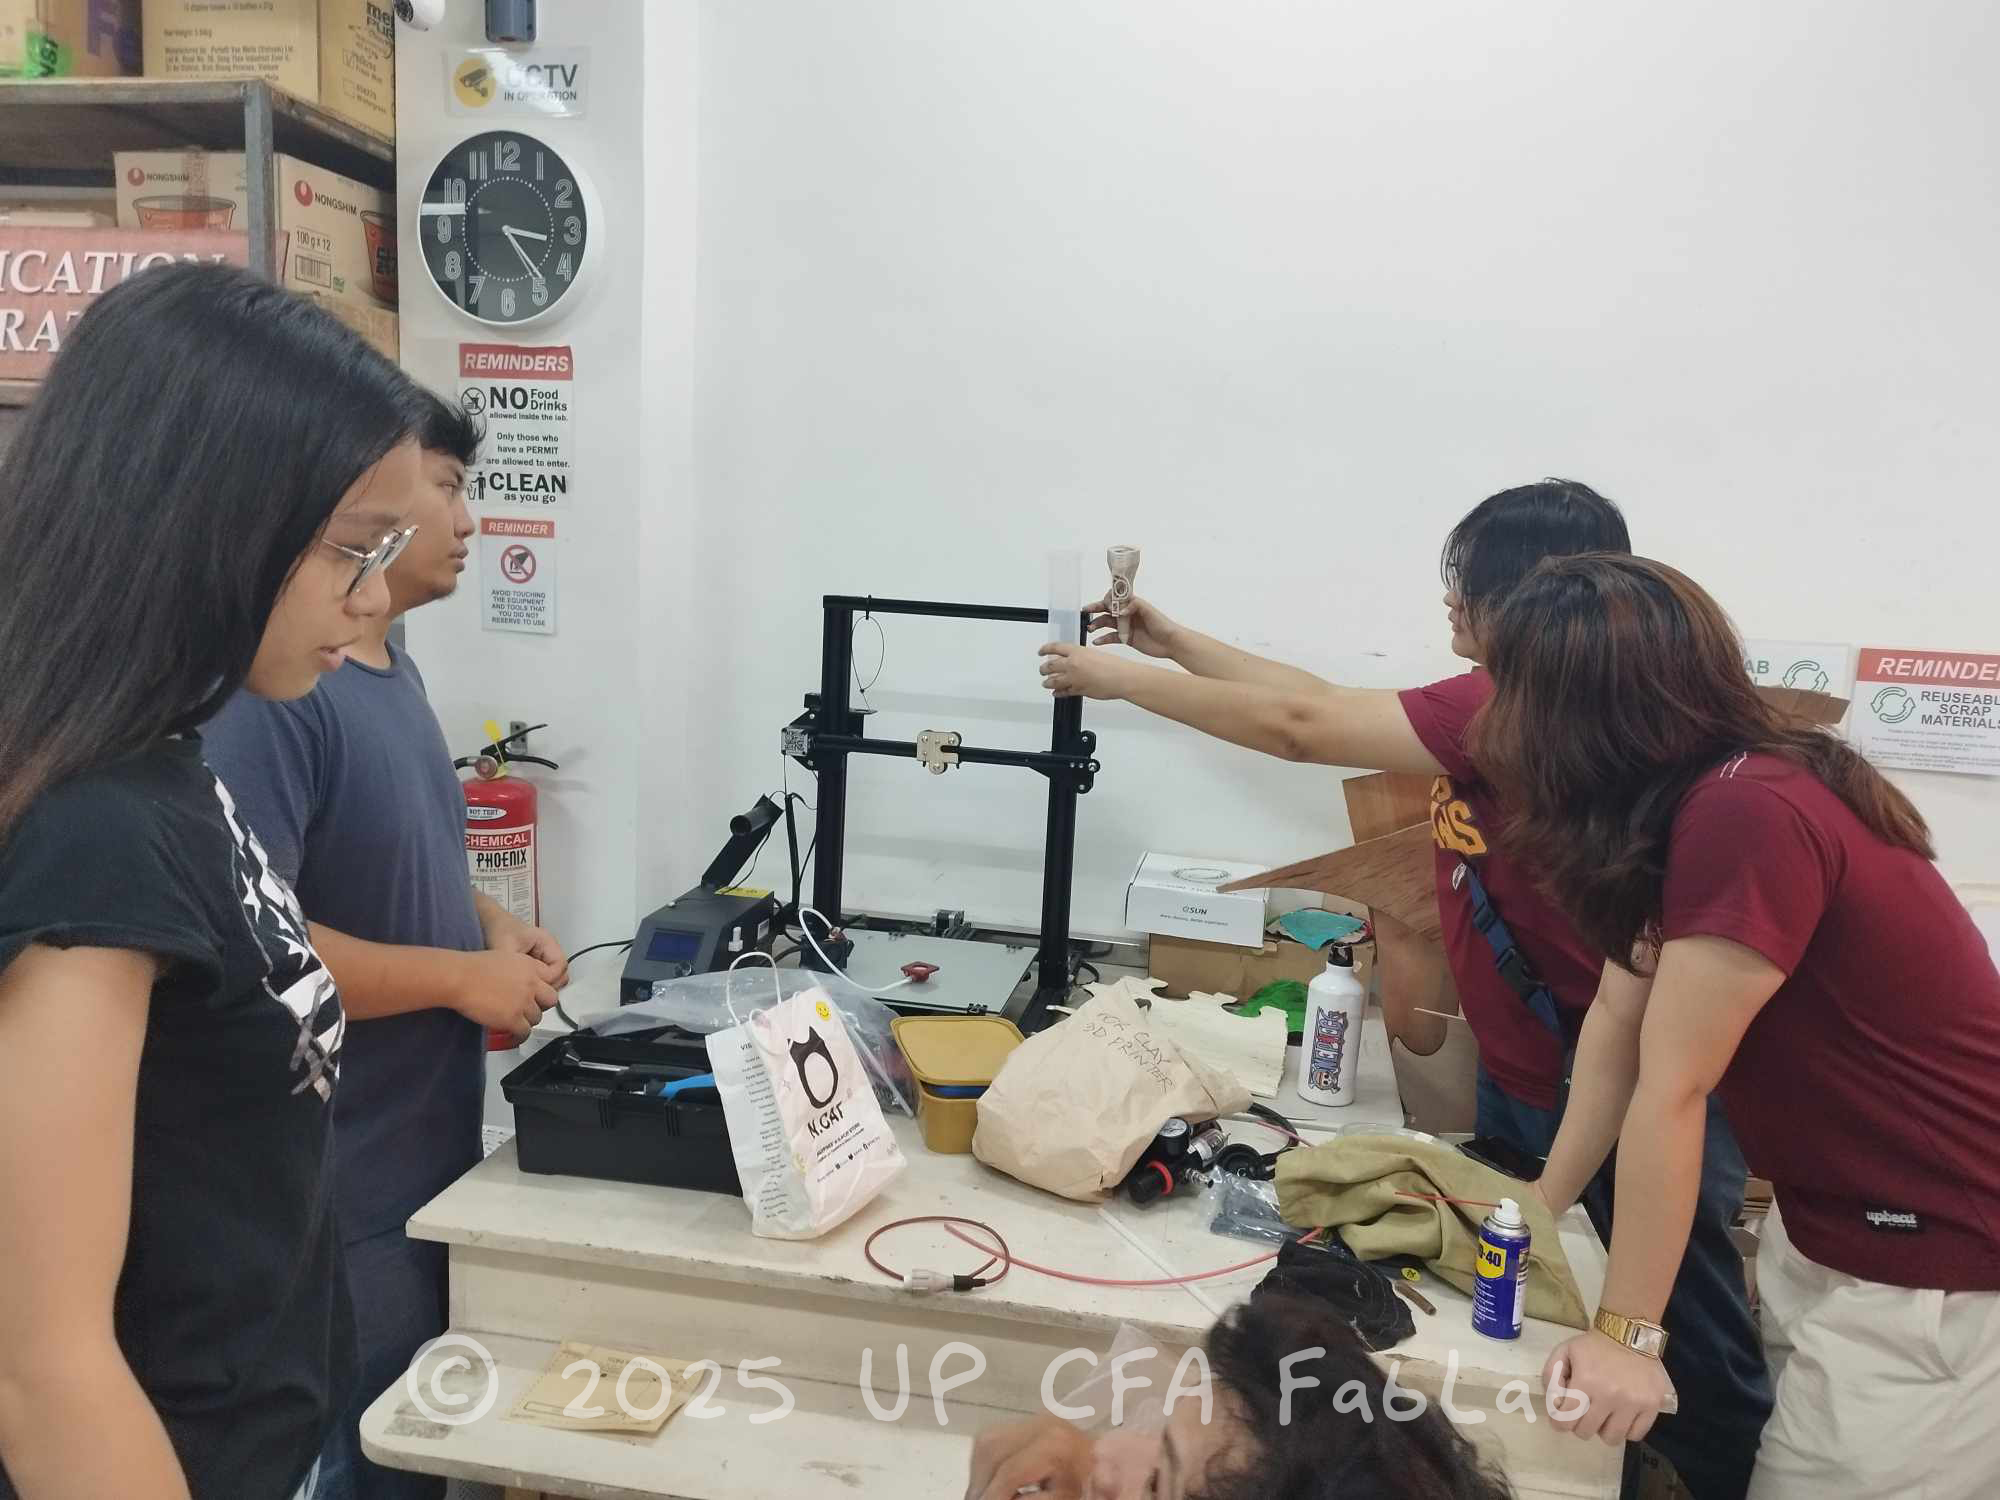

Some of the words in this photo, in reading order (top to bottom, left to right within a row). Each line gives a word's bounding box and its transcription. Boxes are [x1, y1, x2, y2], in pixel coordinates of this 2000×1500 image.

[469, 151, 488, 181] 11
[494, 141, 521, 171] 12
[536, 151, 544, 181] 1
[444, 178, 467, 205] 10
[554, 179, 574, 208] 2
[314, 192, 357, 216] NONGSHIM
[436, 215, 452, 243] 9
[563, 216, 582, 245] 3
[296, 231, 311, 245] 100
[322, 237, 331, 251] 12
[444, 251, 462, 280] 8
[555, 252, 573, 281] 4
[469, 275, 486, 304] 7
[531, 277, 549, 306] 5
[501, 288, 516, 317] 6
[464, 353, 570, 372] REMINDERS
[490, 386, 529, 410] NO
[530, 388, 559, 400] Food
[530, 400, 568, 412] Drinks
[490, 411, 517, 420] allowed
[518, 412, 540, 420] inside
[541, 413, 553, 421] the
[555, 413, 569, 421] lab.
[496, 432, 515, 442] Only
[517, 433, 540, 442] those
[541, 434, 559, 442] who
[497, 445, 517, 454] have
[526, 446, 559, 455] PERMIT
[502, 457, 534, 466] allowed
[536, 459, 545, 467] to
[546, 460, 570, 468] enter.
[489, 472, 567, 494] CLEAN
[504, 493, 517, 501] as
[519, 494, 539, 503] you
[542, 494, 556, 505] go
[488, 521, 549, 535] REMINDER
[491, 589, 511, 597] AVOID
[512, 590, 546, 599] TOUCHING
[507, 597, 544, 606] EQUIPMENT
[507, 604, 528, 612] TOOLS
[491, 616, 520, 625] RESERVE
[523, 618, 532, 626] TO
[1876, 657, 2000, 681] REMINDE
[1939, 703, 1992, 717] SCRAP
[476, 847, 527, 869] PHOENIX
[1866, 1210, 1917, 1226] upbeat
